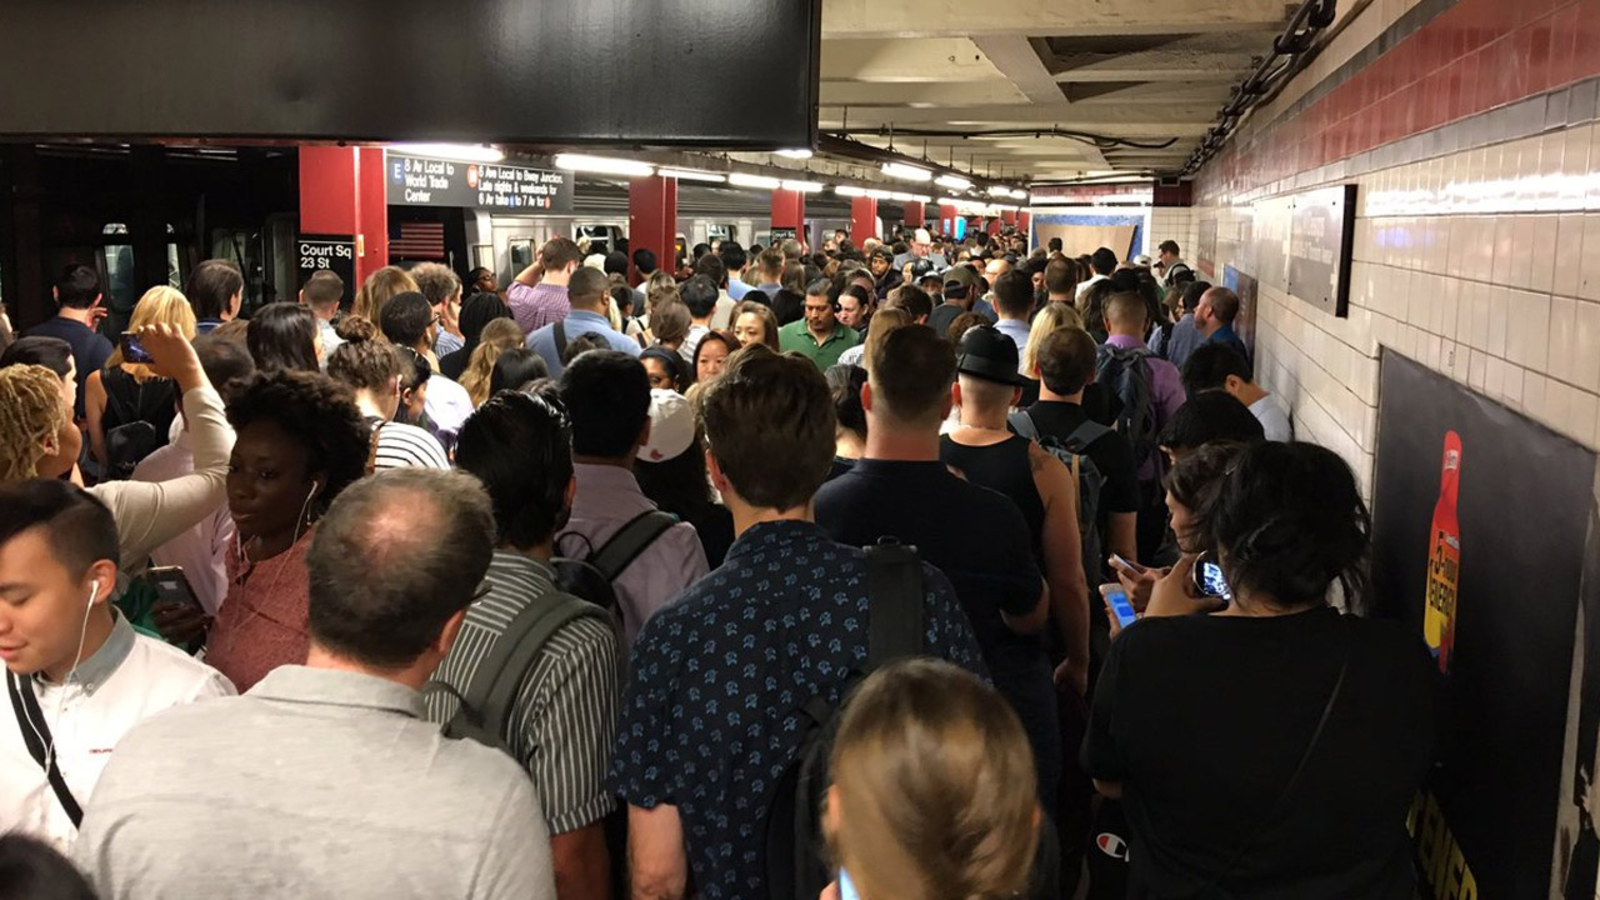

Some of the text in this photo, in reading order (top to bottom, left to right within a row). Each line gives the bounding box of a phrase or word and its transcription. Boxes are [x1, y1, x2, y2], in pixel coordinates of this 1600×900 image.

[394, 163, 402, 179] E
[404, 158, 454, 176] 8 Av Local to
[499, 168, 515, 180] Local
[516, 170, 522, 180] to
[404, 173, 449, 190] World Trade
[479, 180, 492, 192] Late
[494, 181, 512, 196] nights
[520, 184, 548, 195] weekends
[404, 188, 431, 202] Center
[479, 193, 484, 204] 6
[495, 194, 509, 206] take
[515, 195, 521, 206] to
[523, 195, 527, 206] 7
[301, 244, 351, 260] Court Sq
[301, 257, 330, 268] 23 St
